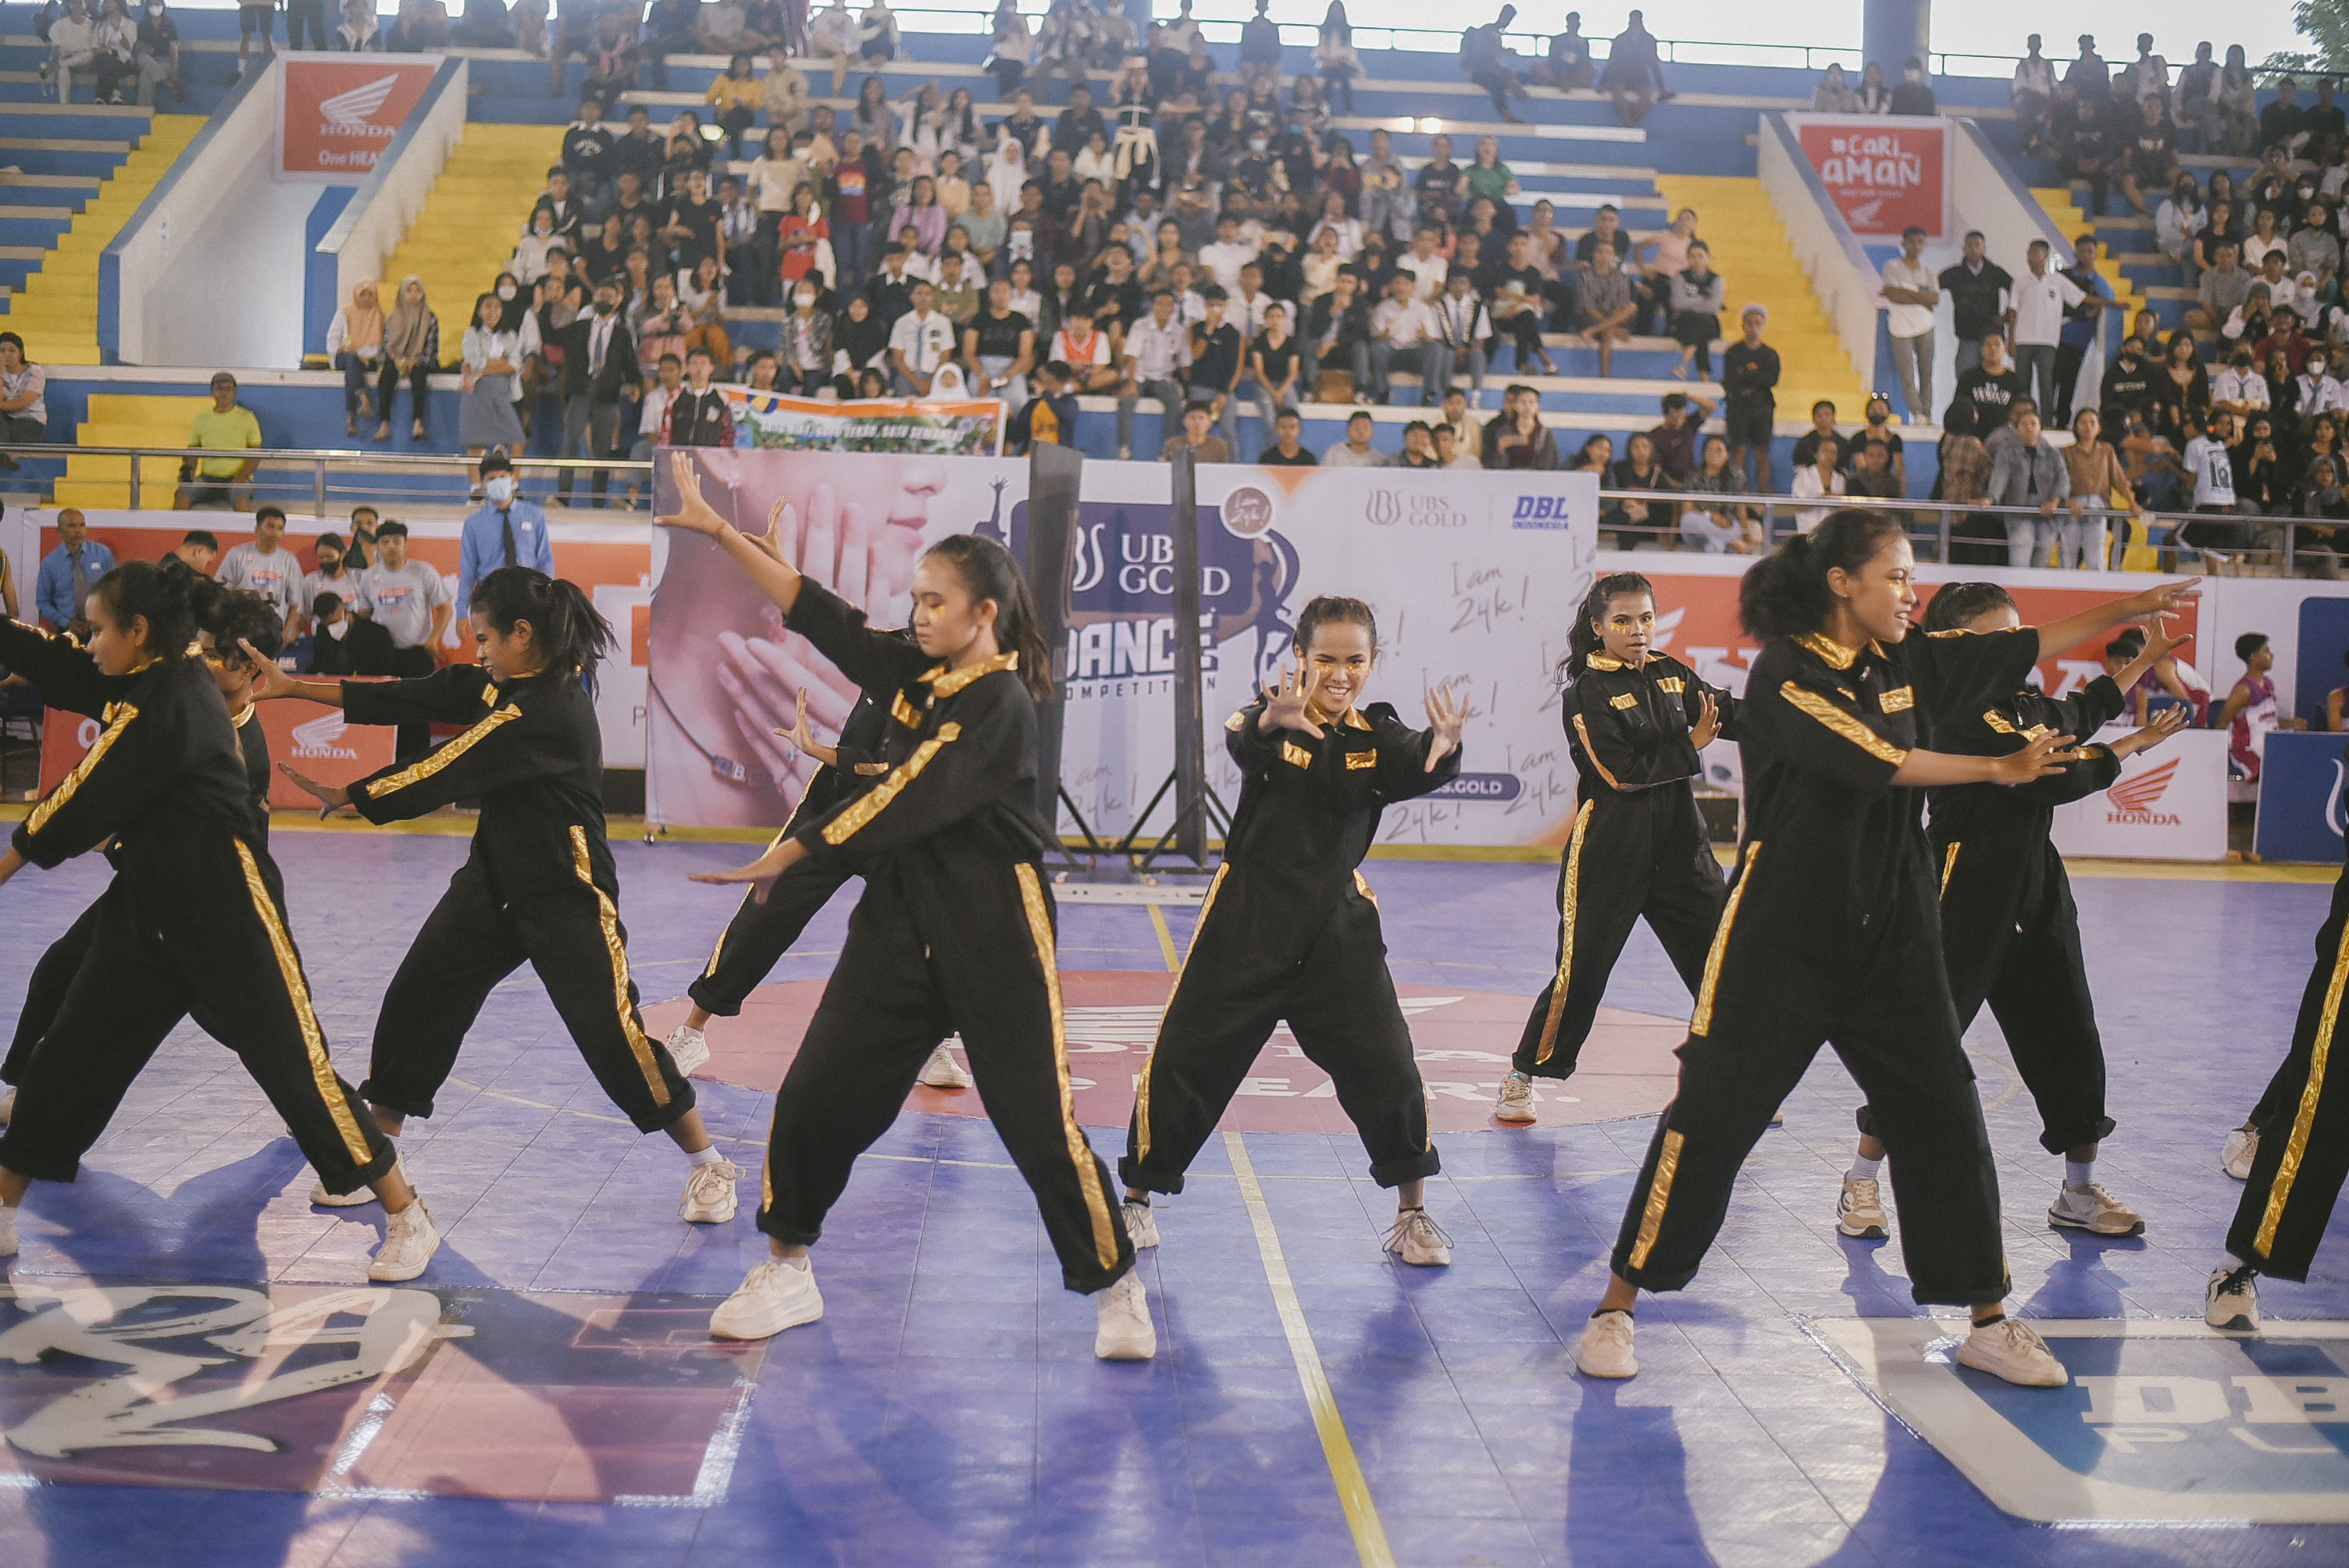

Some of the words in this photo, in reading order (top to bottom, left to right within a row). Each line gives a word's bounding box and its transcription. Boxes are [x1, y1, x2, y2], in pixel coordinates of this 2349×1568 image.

[319, 124, 397, 136] HONDA
[1410, 496, 1449, 510] UBS
[1513, 496, 1568, 519] DBL
[1409, 511, 1466, 527] GOLD
[1121, 533, 1174, 564] UB
[1118, 564, 1231, 596] GOD
[1466, 567, 1502, 589] am
[291, 747, 358, 760] HONDA
[1503, 769, 1567, 817] 24k
[2106, 812, 2182, 826] HONDA
[2075, 1375, 2349, 1424] DB
